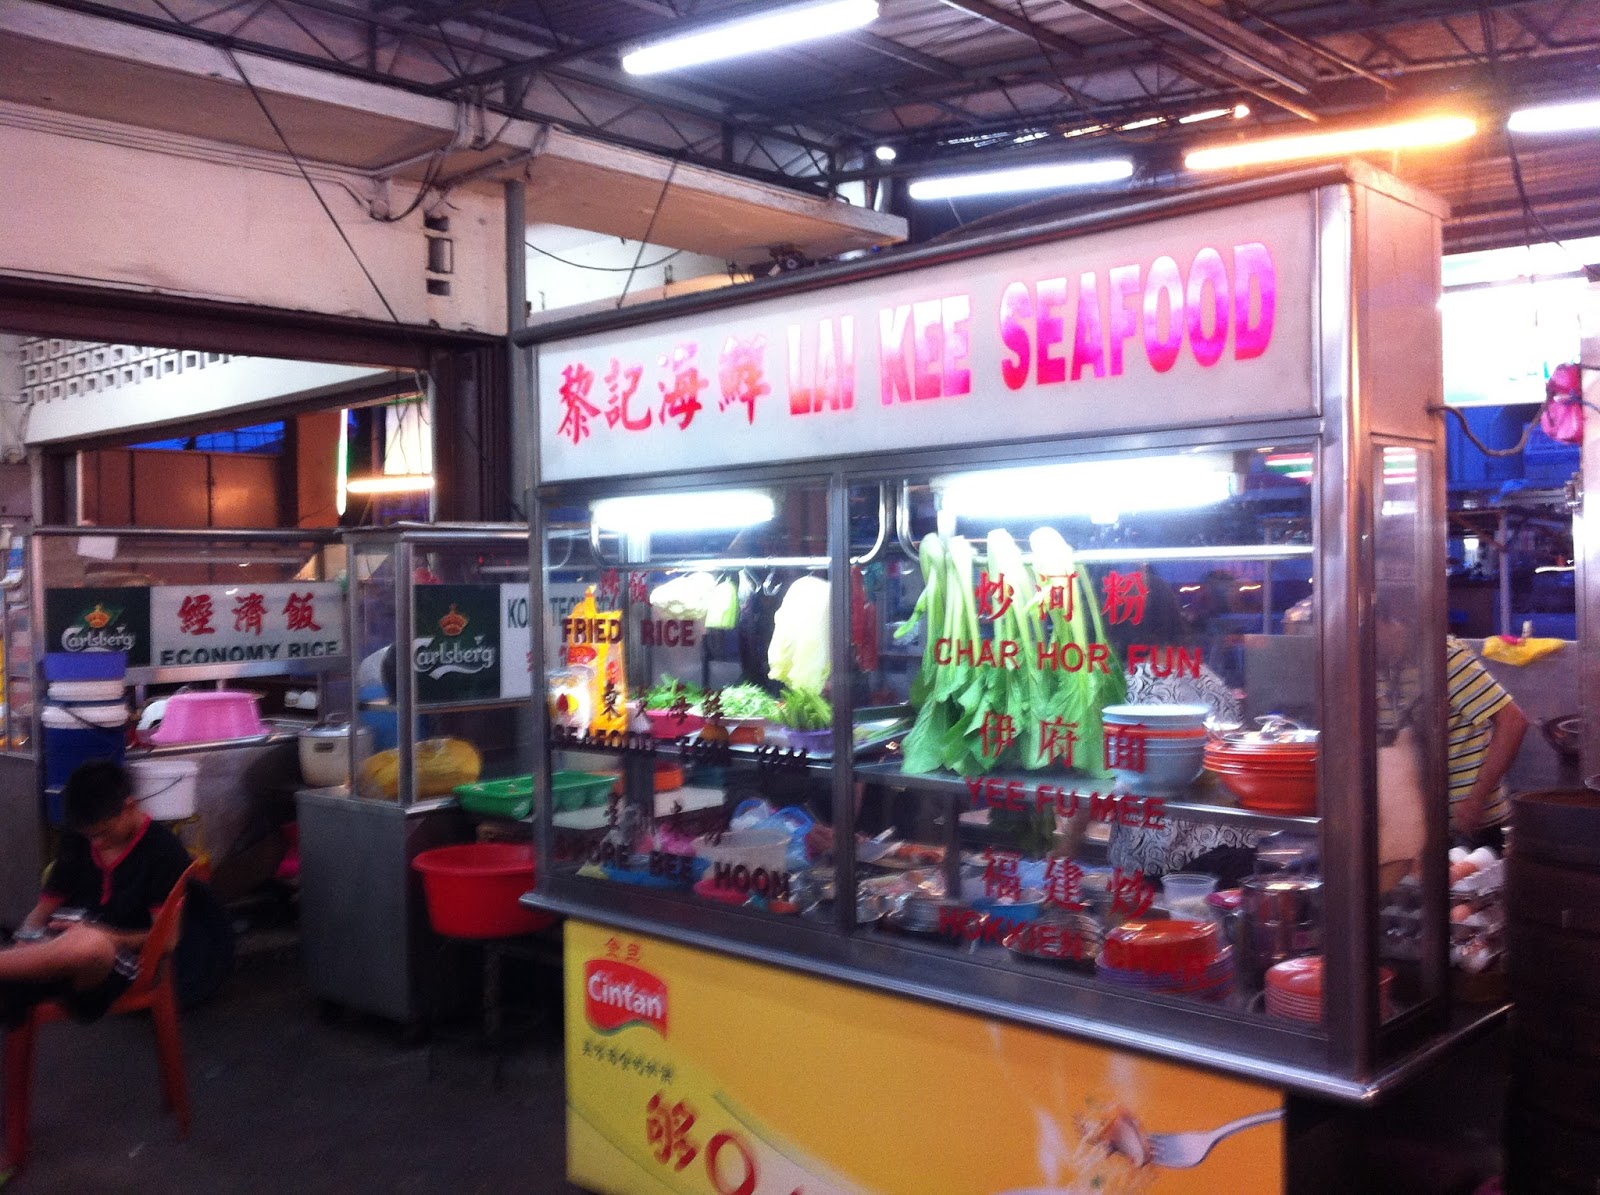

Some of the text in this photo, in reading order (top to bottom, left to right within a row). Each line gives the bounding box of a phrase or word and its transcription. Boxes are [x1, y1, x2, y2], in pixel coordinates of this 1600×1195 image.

[785, 241, 1277, 416] LAI KEE SEAFOOD
[178, 591, 322, 637] 經濟飯
[974, 570, 1150, 626] 炒河粉
[61, 623, 136, 653] Carlsberg
[160, 640, 339, 666] ECONOMY RICE
[562, 617, 696, 648] FRIED RICE
[411, 635, 497, 672] Carlsberg
[934, 638, 1203, 679] CHAR HOR FUN
[964, 775, 1167, 830] YEE FU MEE
[714, 861, 791, 898] HOON
[588, 969, 663, 1019] Cintan
